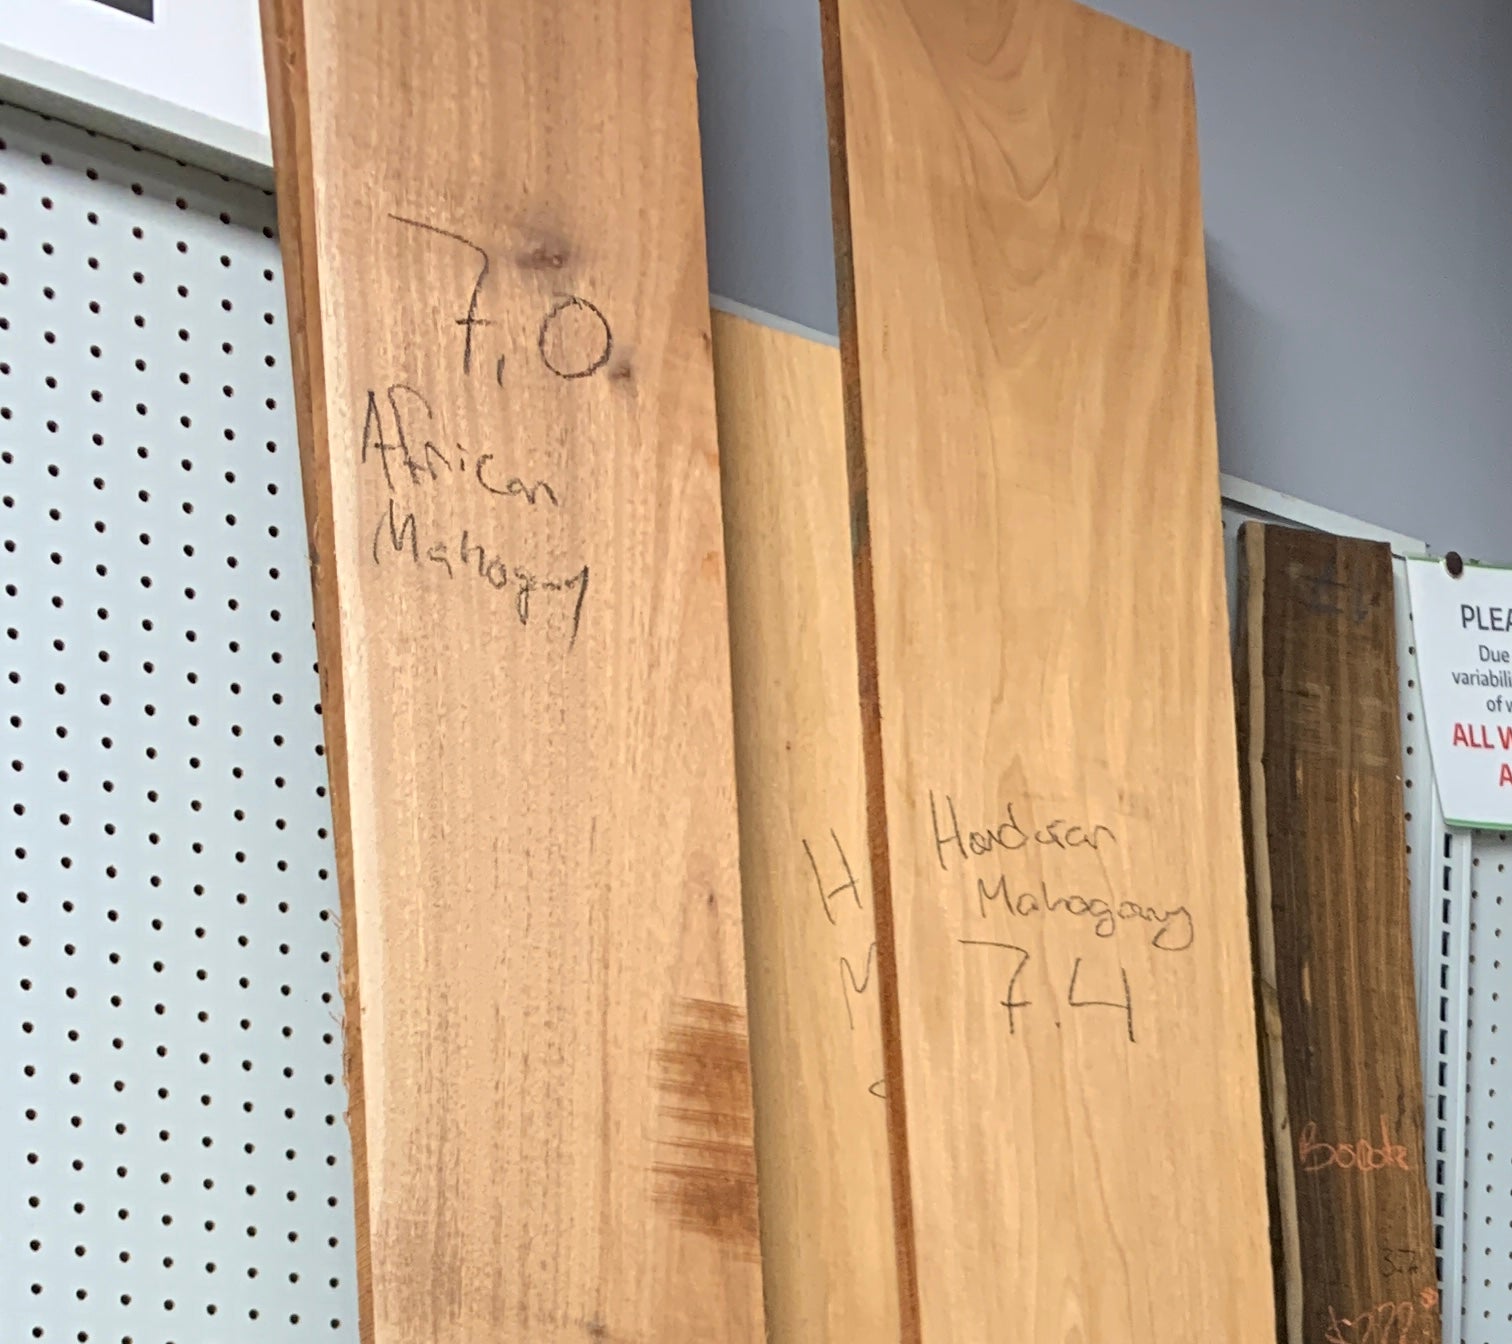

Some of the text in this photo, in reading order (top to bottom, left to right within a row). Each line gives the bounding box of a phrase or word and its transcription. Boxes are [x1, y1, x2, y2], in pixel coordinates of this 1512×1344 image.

[361, 383, 560, 506] African
[1479, 644, 1510, 664] Due
[1486, 695, 1503, 712] of
[1453, 723, 1495, 750] ALL
[802, 828, 862, 925] H
